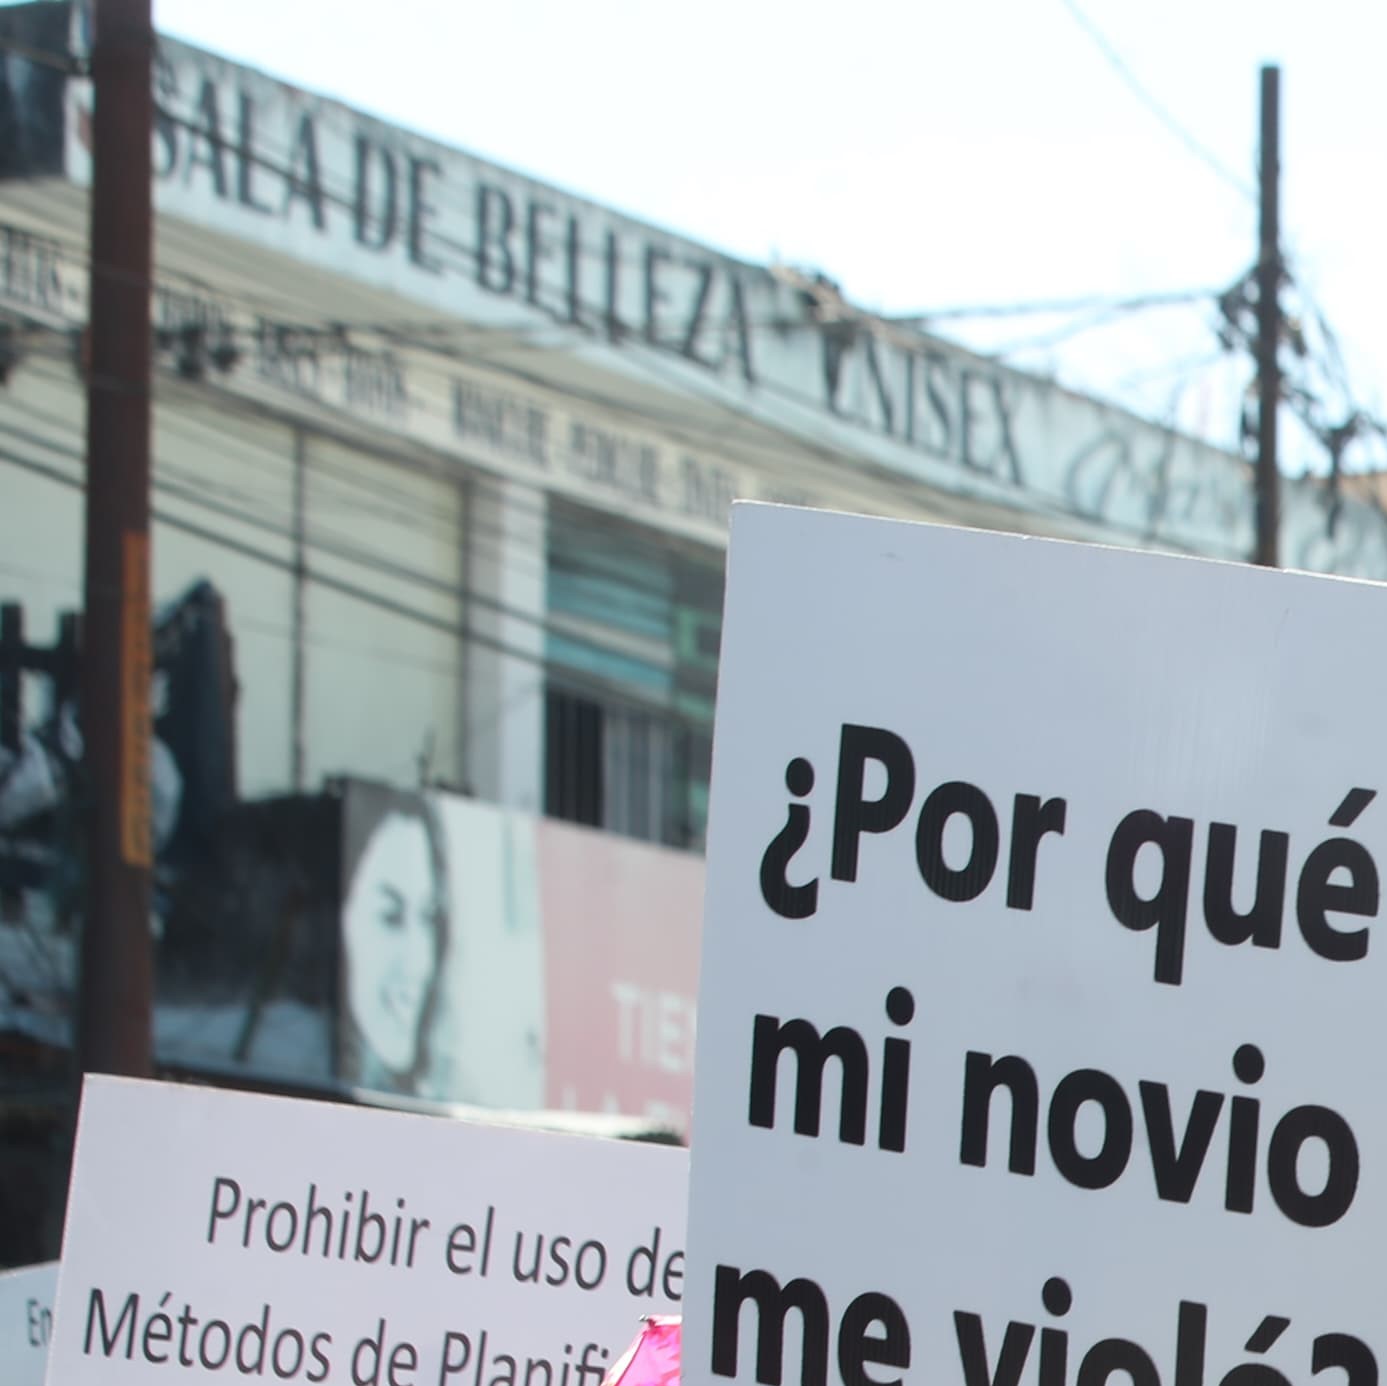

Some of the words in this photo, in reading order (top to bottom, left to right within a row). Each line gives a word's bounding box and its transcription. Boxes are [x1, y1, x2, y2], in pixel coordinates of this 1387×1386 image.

[353, 127, 444, 279] DE
[474, 180, 760, 386] BELLEZA
[758, 722, 1067, 919] ¿Por
[1105, 787, 1380, 985] qué
[610, 980, 697, 1076] TIE
[748, 985, 916, 1153] mi
[960, 1043, 1360, 1229] novio
[206, 1176, 430, 1268] Prohibir
[445, 1206, 495, 1278] el
[512, 1231, 607, 1291] uso
[626, 1227, 684, 1301] de
[83, 1288, 332, 1383] Métodos
